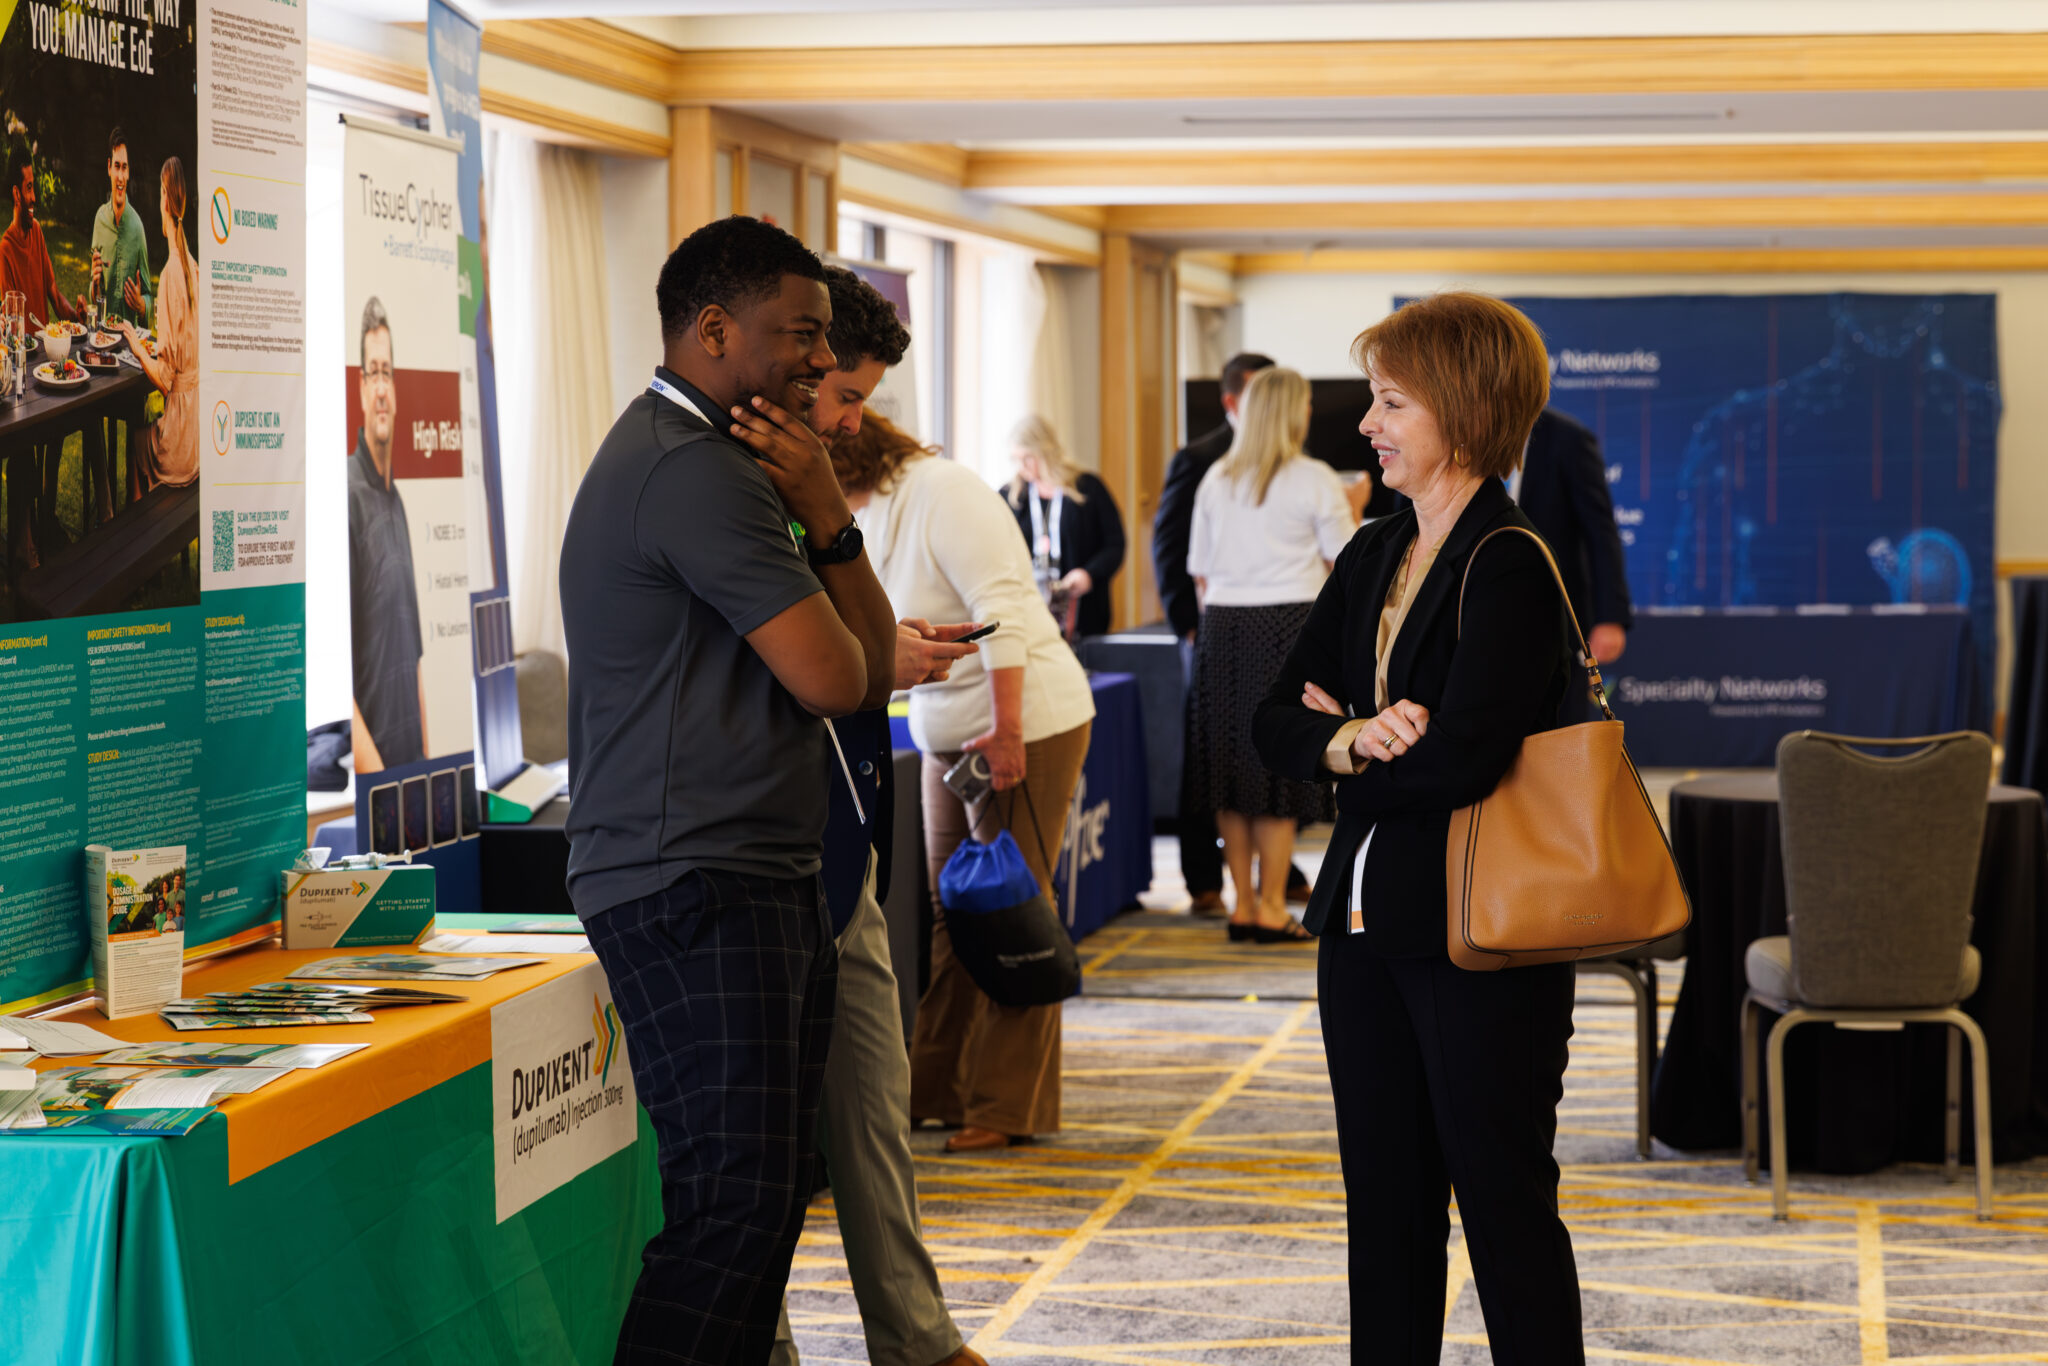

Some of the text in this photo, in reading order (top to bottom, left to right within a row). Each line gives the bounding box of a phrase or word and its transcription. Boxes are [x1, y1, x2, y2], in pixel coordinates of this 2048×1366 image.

[29, 1, 60, 55] YOU
[64, 10, 126, 69] MANAGE
[130, 26, 154, 75] EoE
[359, 173, 452, 239] TissueCypher
[234, 209, 241, 225] NO
[241, 210, 256, 228] BOXED
[211, 260, 287, 277] SELECT IMPORTANT SAFETY INFORMATION
[1560, 348, 1661, 373] Networks
[412, 420, 438, 458] High
[87, 629, 112, 641] IMPORTANT
[113, 627, 127, 639] SAFETY
[128, 625, 156, 637] INFORMATION
[1619, 675, 1828, 705] Specialty Networks
[88, 749, 119, 764] STUDY DESIGN:
[113, 886, 132, 896] DOSAGE
[113, 893, 153, 905] ADMINISTRATION
[300, 887, 350, 897] DUPIXENT
[113, 905, 128, 915] GUIDE
[512, 1040, 592, 1120] DUPIXENT
[513, 1098, 570, 1165] (dupilumab)
[604, 1085, 624, 1108] 300mg
